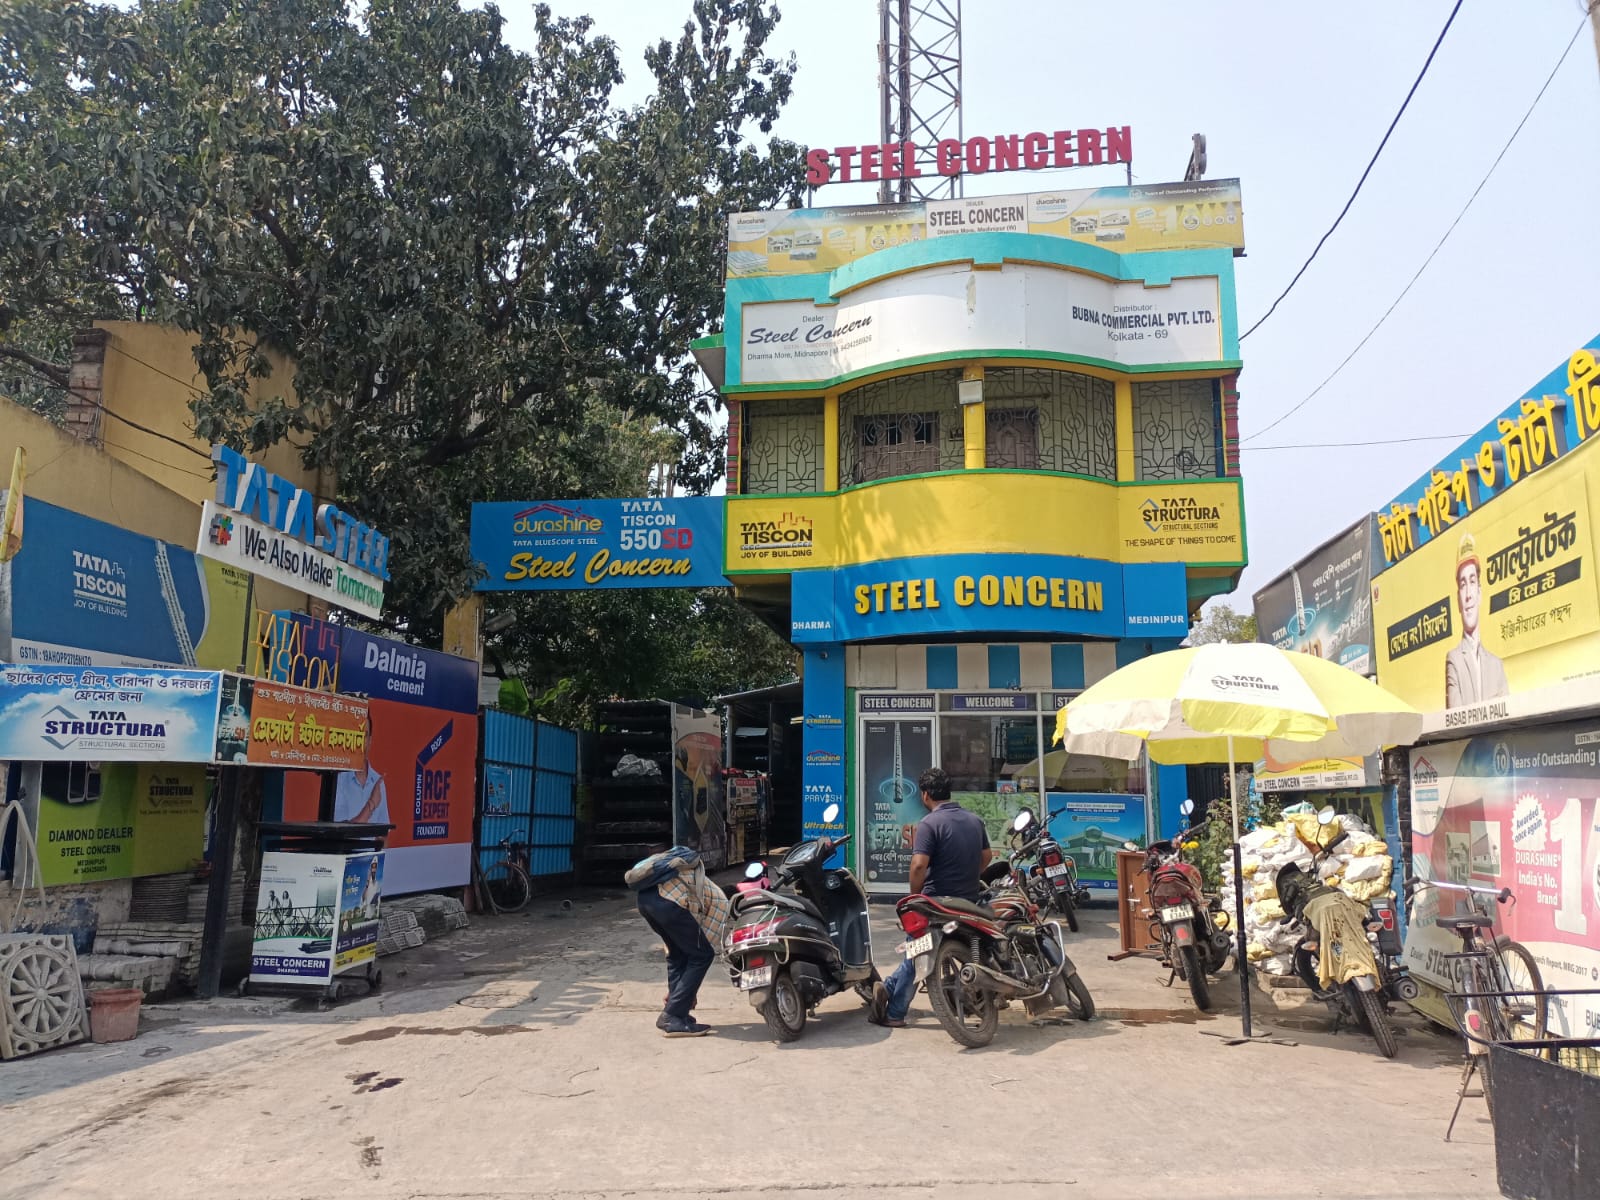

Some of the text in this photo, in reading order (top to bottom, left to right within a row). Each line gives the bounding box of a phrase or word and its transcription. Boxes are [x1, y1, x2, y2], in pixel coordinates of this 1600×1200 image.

[807, 125, 1132, 184] STEEL CONCERN
[929, 210, 967, 226] STEEL
[969, 206, 1024, 223] CONCERN
[1072, 305, 1215, 329] BUBNA COMMERCIAL PVT. LTD.
[1114, 305, 1152, 313] Distributor
[802, 315, 824, 323] Dealer
[747, 316, 873, 344] Steel Concern
[1107, 330, 1144, 342] Kolkata
[1154, 329, 1168, 339] 69
[1378, 503, 1415, 562] টাটা
[1417, 458, 1473, 536] পাইপ
[1475, 441, 1496, 488] ও
[1498, 395, 1560, 482] টাটা
[621, 500, 663, 512] TATA
[1161, 497, 1197, 507] TATA
[212, 444, 391, 582] TATA STEEL
[621, 514, 676, 527] TISCON
[1143, 507, 1220, 522] STRUCTURA
[514, 513, 603, 533] durashine
[740, 522, 776, 532] TATA
[1163, 522, 1218, 531] STRUCTURAL SECTIONS
[620, 527, 693, 551] 550SD
[741, 529, 813, 544] TISCON
[1125, 534, 1237, 547] THE SHAPE OF THINGS TO COME
[772, 549, 812, 557] BUILDING
[1486, 511, 1577, 587] আল্ট্রাটেক
[73, 550, 111, 575] TATA
[244, 525, 386, 610] We Also Make Tomorrow
[504, 548, 692, 583] Steel Concern
[73, 571, 126, 599] TISCON
[854, 575, 1105, 615] STEEL CONCERN
[74, 599, 128, 618] JOY OF BUILDING
[792, 621, 832, 630] DHARMA
[1128, 615, 1184, 625] MEDINIPUR
[256, 610, 302, 655] TATA
[20, 646, 38, 661] GSTIN
[364, 642, 427, 681] Dalmia
[251, 640, 340, 693] TISCON
[6, 670, 211, 690] ছাদের শেড, গ্রীল, বারান্দা ও দরজার
[387, 677, 424, 697] cement
[1211, 679, 1279, 691] STRUCTURA
[1231, 675, 1264, 683] TATA
[75, 690, 144, 703] ফ্রেমের জন্য
[864, 696, 932, 708] STEEL CONCERN
[966, 696, 1015, 708] WELLCOME
[89, 711, 127, 721] TATA
[1445, 702, 1510, 728] BASAB PRIYA PAUL
[45, 721, 166, 737] STRUCTURA
[253, 709, 296, 746] মেসার্স
[328, 721, 367, 752] কনসার্ন
[79, 740, 165, 749] STRUCTURAL SECTIONS
[806, 754, 841, 762] durashine
[1496, 750, 1596, 769] 10 Years of Outstanding
[424, 769, 451, 800] RCF
[1264, 777, 1300, 790] STEEL CONCERN
[804, 794, 842, 803] PRAVESH
[874, 802, 890, 811] TATA
[423, 802, 449, 819] EXPERT
[875, 812, 897, 821] TISCON
[1516, 804, 1540, 830] Awarded
[49, 826, 134, 842] DIAMOND DEALER
[416, 826, 445, 836] FOUNDATION
[804, 822, 844, 830] UltraTech
[1515, 818, 1543, 843] once again
[60, 844, 121, 857] STEEL CONCERN
[1550, 798, 1587, 935] 1
[1518, 870, 1557, 888] India's No.
[1537, 890, 1558, 906] Brand
[253, 956, 326, 969] STEEL CONCERN
[1425, 948, 1452, 980] STEEL
[1575, 965, 1588, 977] 2017
